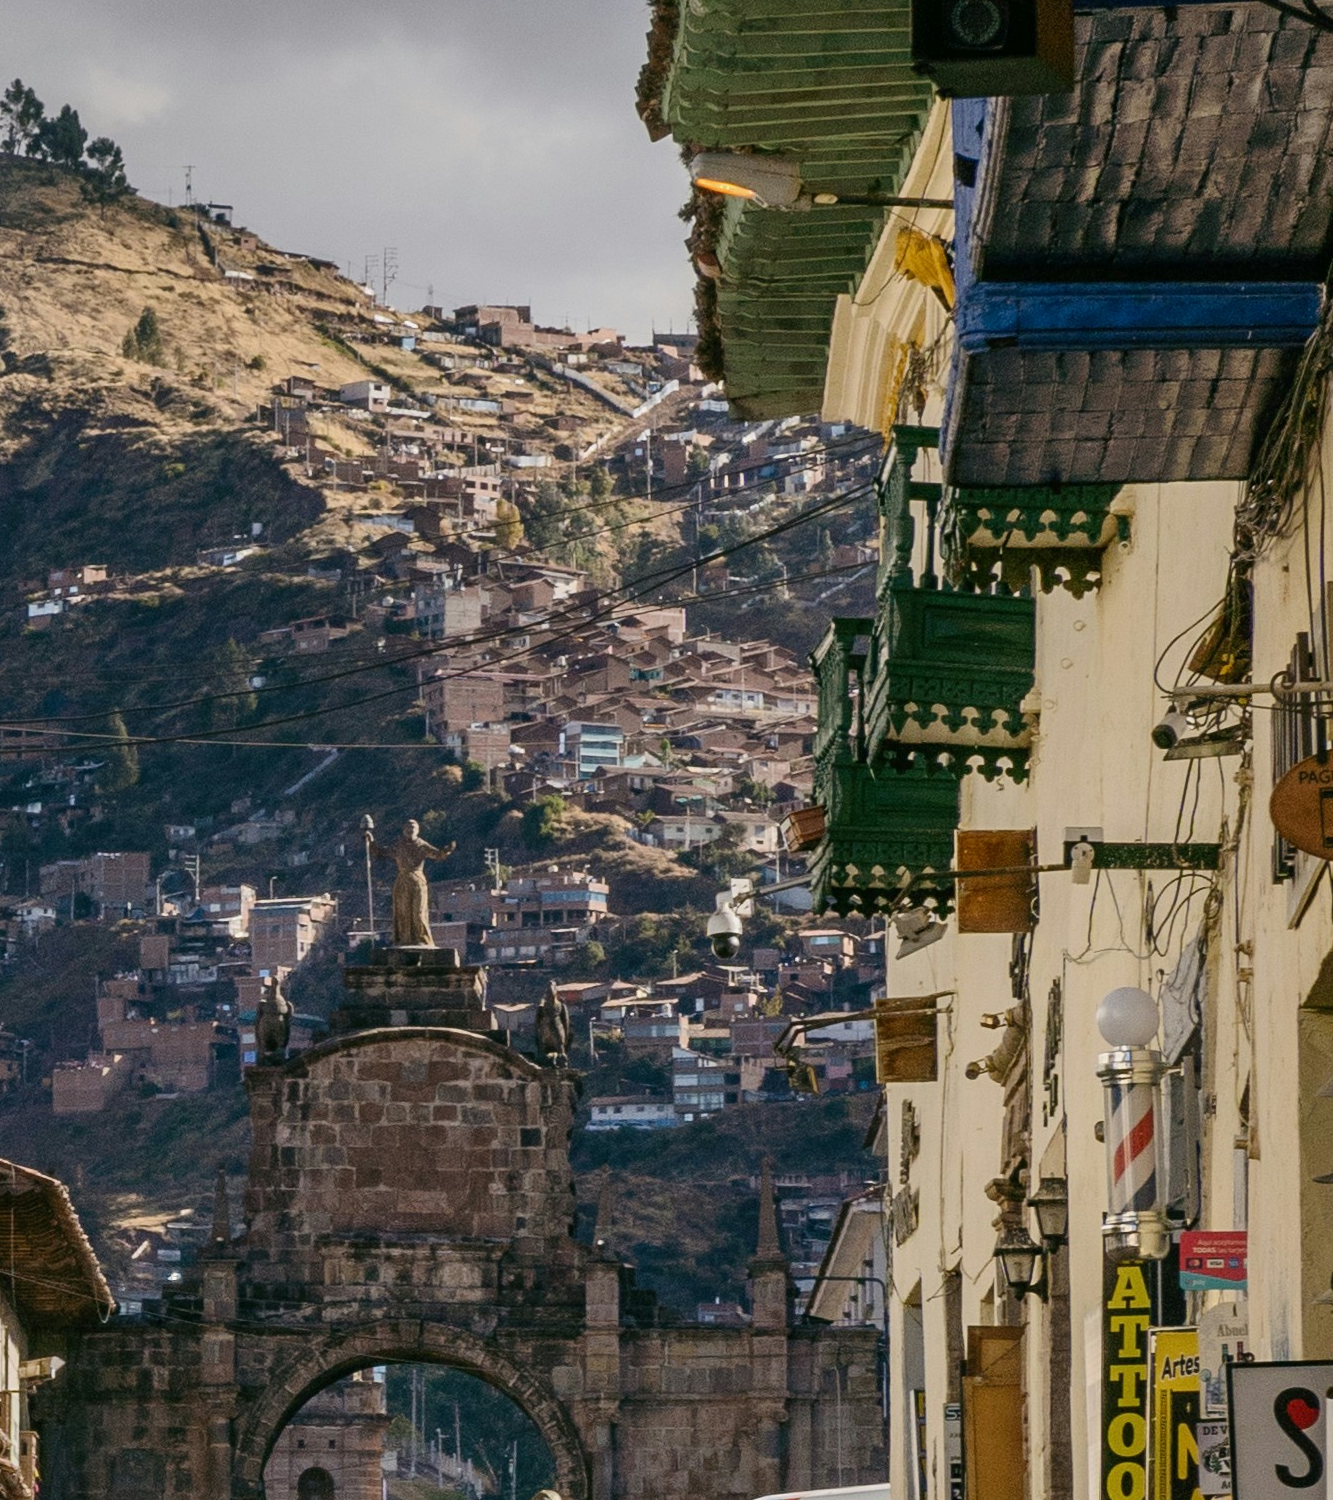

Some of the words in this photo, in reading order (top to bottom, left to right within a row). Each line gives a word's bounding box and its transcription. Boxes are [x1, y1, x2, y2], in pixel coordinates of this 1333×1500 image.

[1298, 770, 1333, 784] PAG
[1160, 1353, 1200, 1382] Artes
[1203, 1425, 1218, 1436] DE
